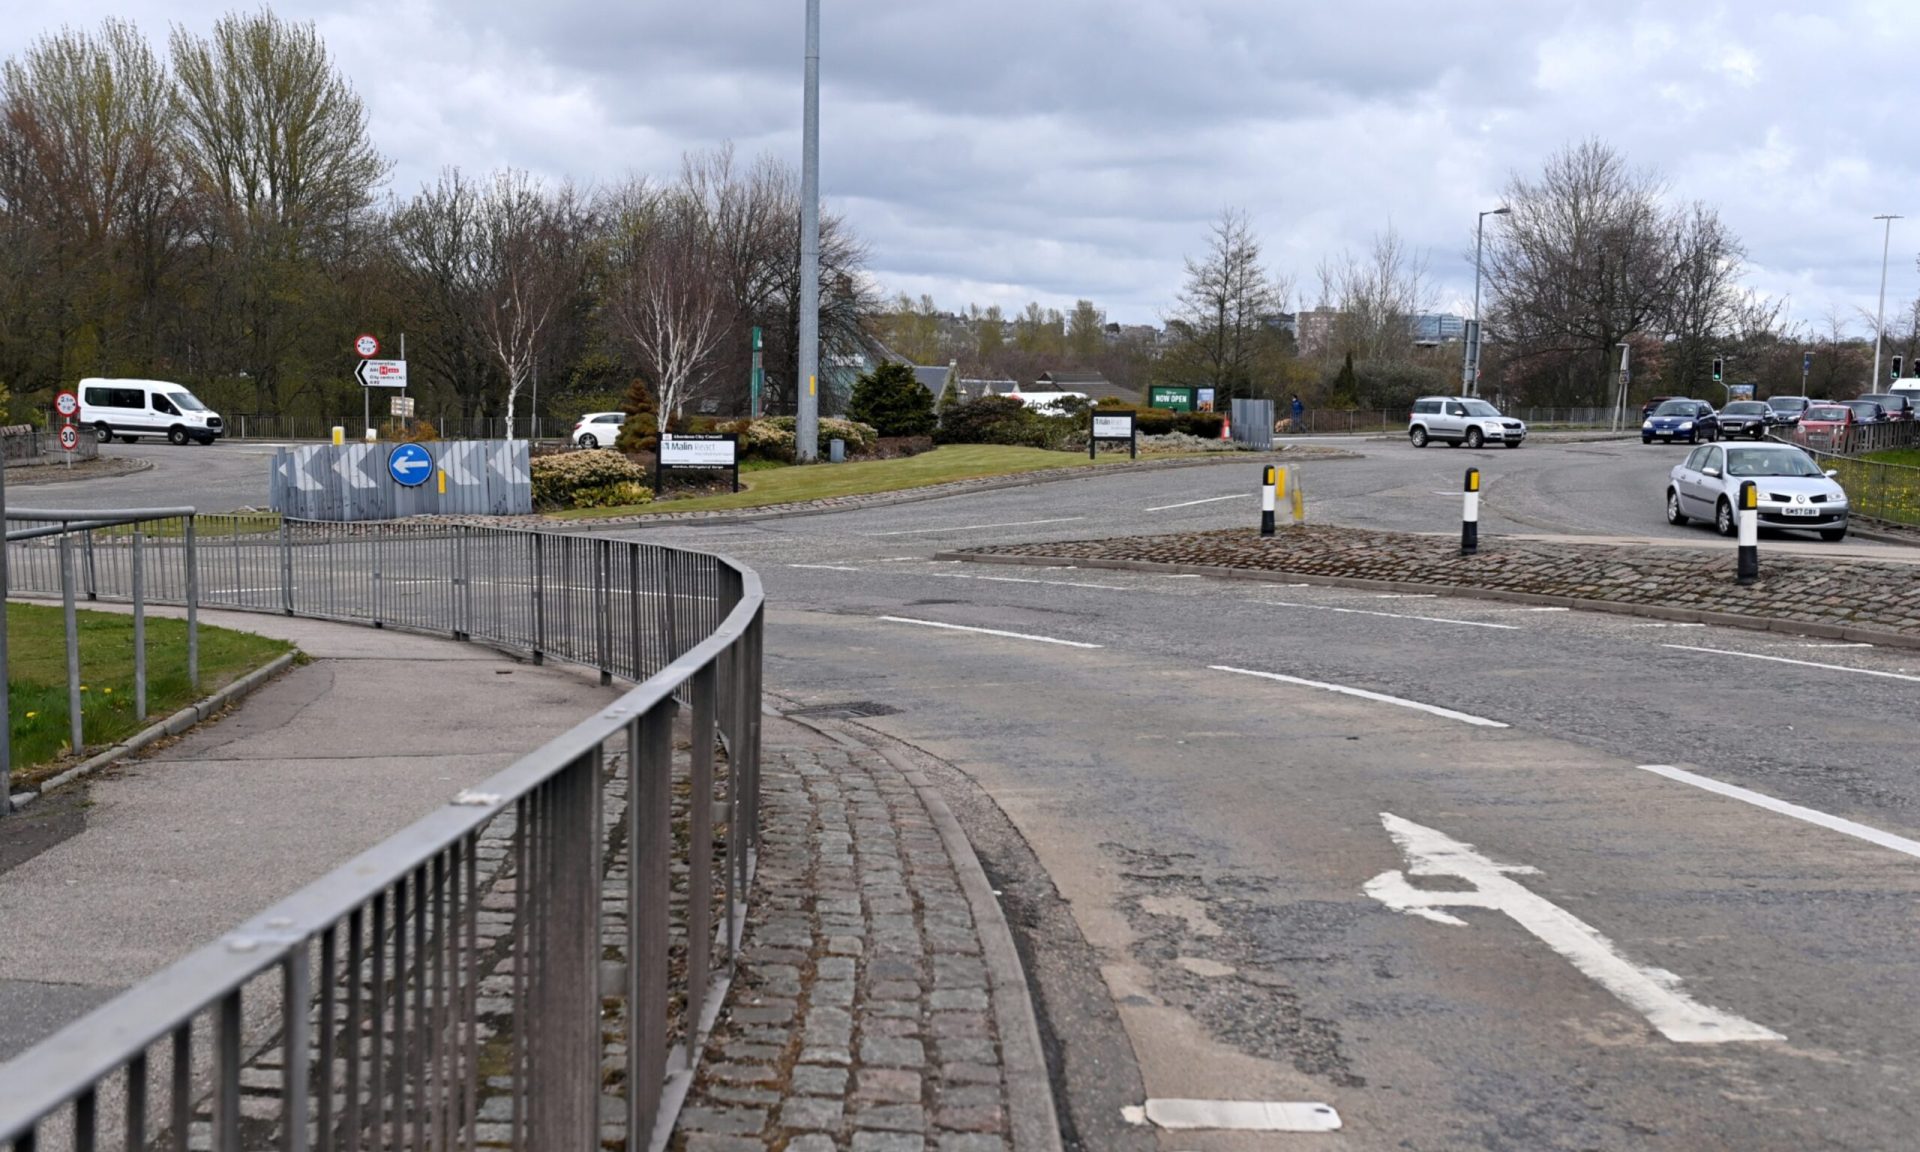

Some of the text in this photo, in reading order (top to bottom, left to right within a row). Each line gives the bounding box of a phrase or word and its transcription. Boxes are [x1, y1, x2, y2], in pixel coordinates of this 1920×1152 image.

[1156, 394, 1170, 402] NOW
[63, 432, 75, 442] 30
[672, 442, 693, 451] Malin
